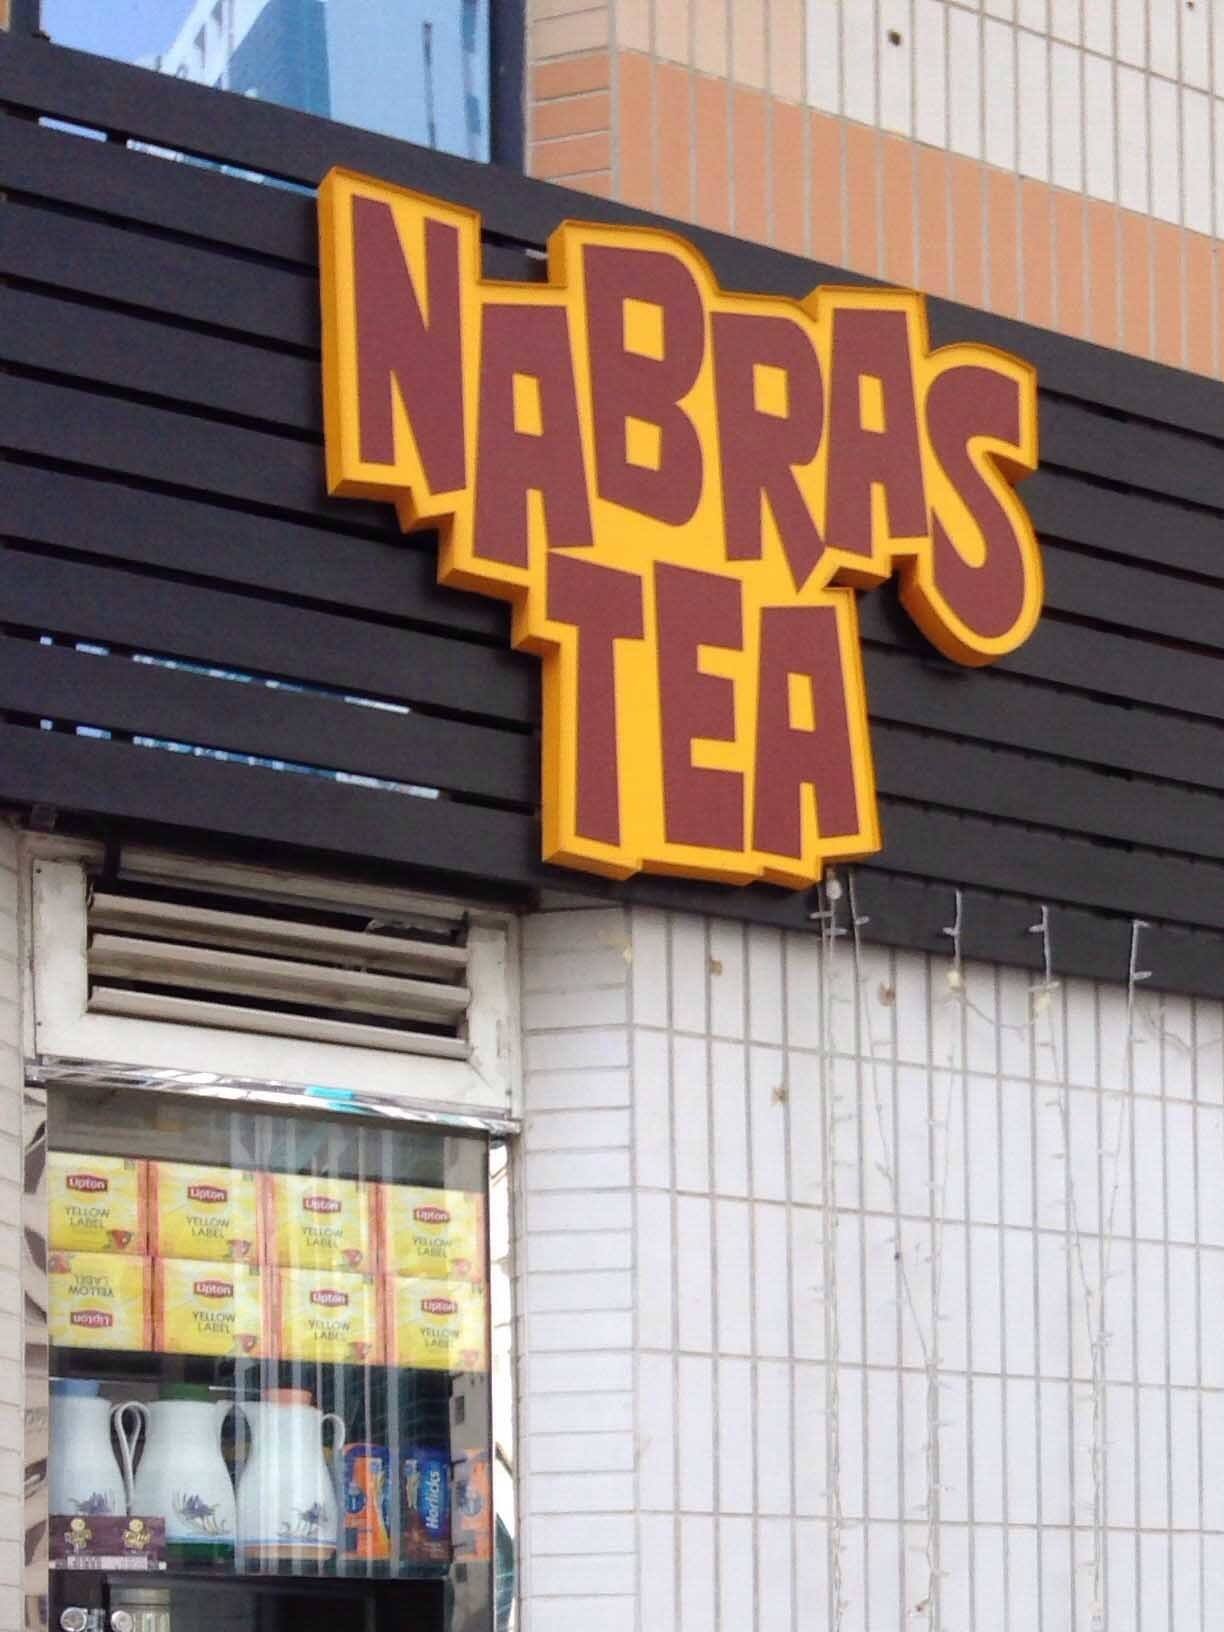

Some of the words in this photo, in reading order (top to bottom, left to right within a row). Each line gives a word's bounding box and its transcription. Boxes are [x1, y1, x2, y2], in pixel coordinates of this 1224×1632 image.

[351, 194, 1026, 639] NABRAS
[545, 550, 859, 860] TEA
[69, 1176, 107, 1191] Lipton
[190, 1188, 226, 1202] Lipton
[305, 1198, 340, 1211] Lipton
[65, 1207, 111, 1219] YELLOW
[415, 1208, 449, 1222] Lipton
[70, 1217, 106, 1230] LABEL
[186, 1216, 230, 1229] YELLOW
[191, 1227, 226, 1240] LABEL
[300, 1226, 344, 1238] YELLOW
[196, 1283, 232, 1297] Lipton
[312, 1292, 347, 1305] Lipton
[423, 1300, 456, 1314] Lipton
[192, 1311, 236, 1323] YELLOW
[197, 1322, 232, 1335] LABEL
[425, 1471, 441, 1530] Horlicks
